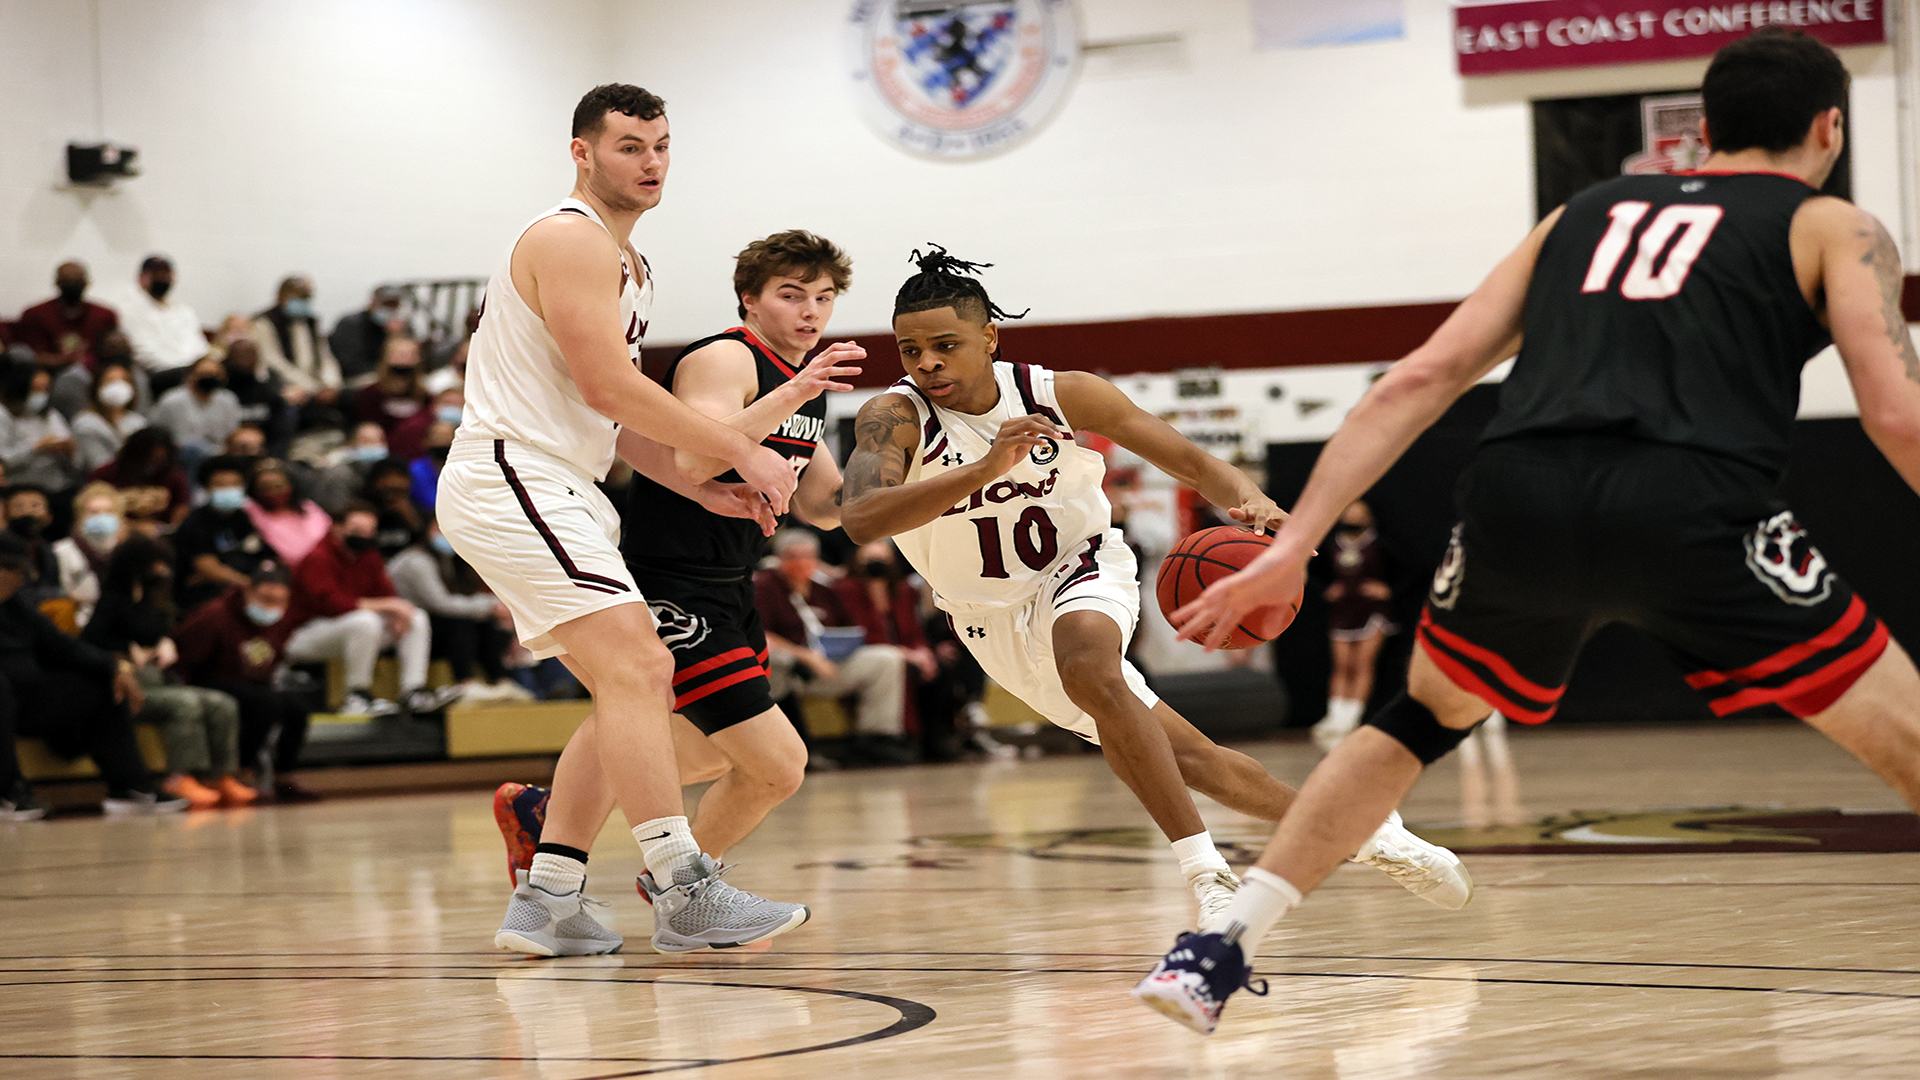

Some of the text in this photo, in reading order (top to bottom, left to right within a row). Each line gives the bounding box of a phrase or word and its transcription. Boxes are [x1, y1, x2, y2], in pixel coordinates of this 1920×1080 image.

[1456, 0, 1875, 54] EAST COAST CONFERENCE
[1580, 199, 1726, 301] 10
[968, 505, 1058, 579] 10
